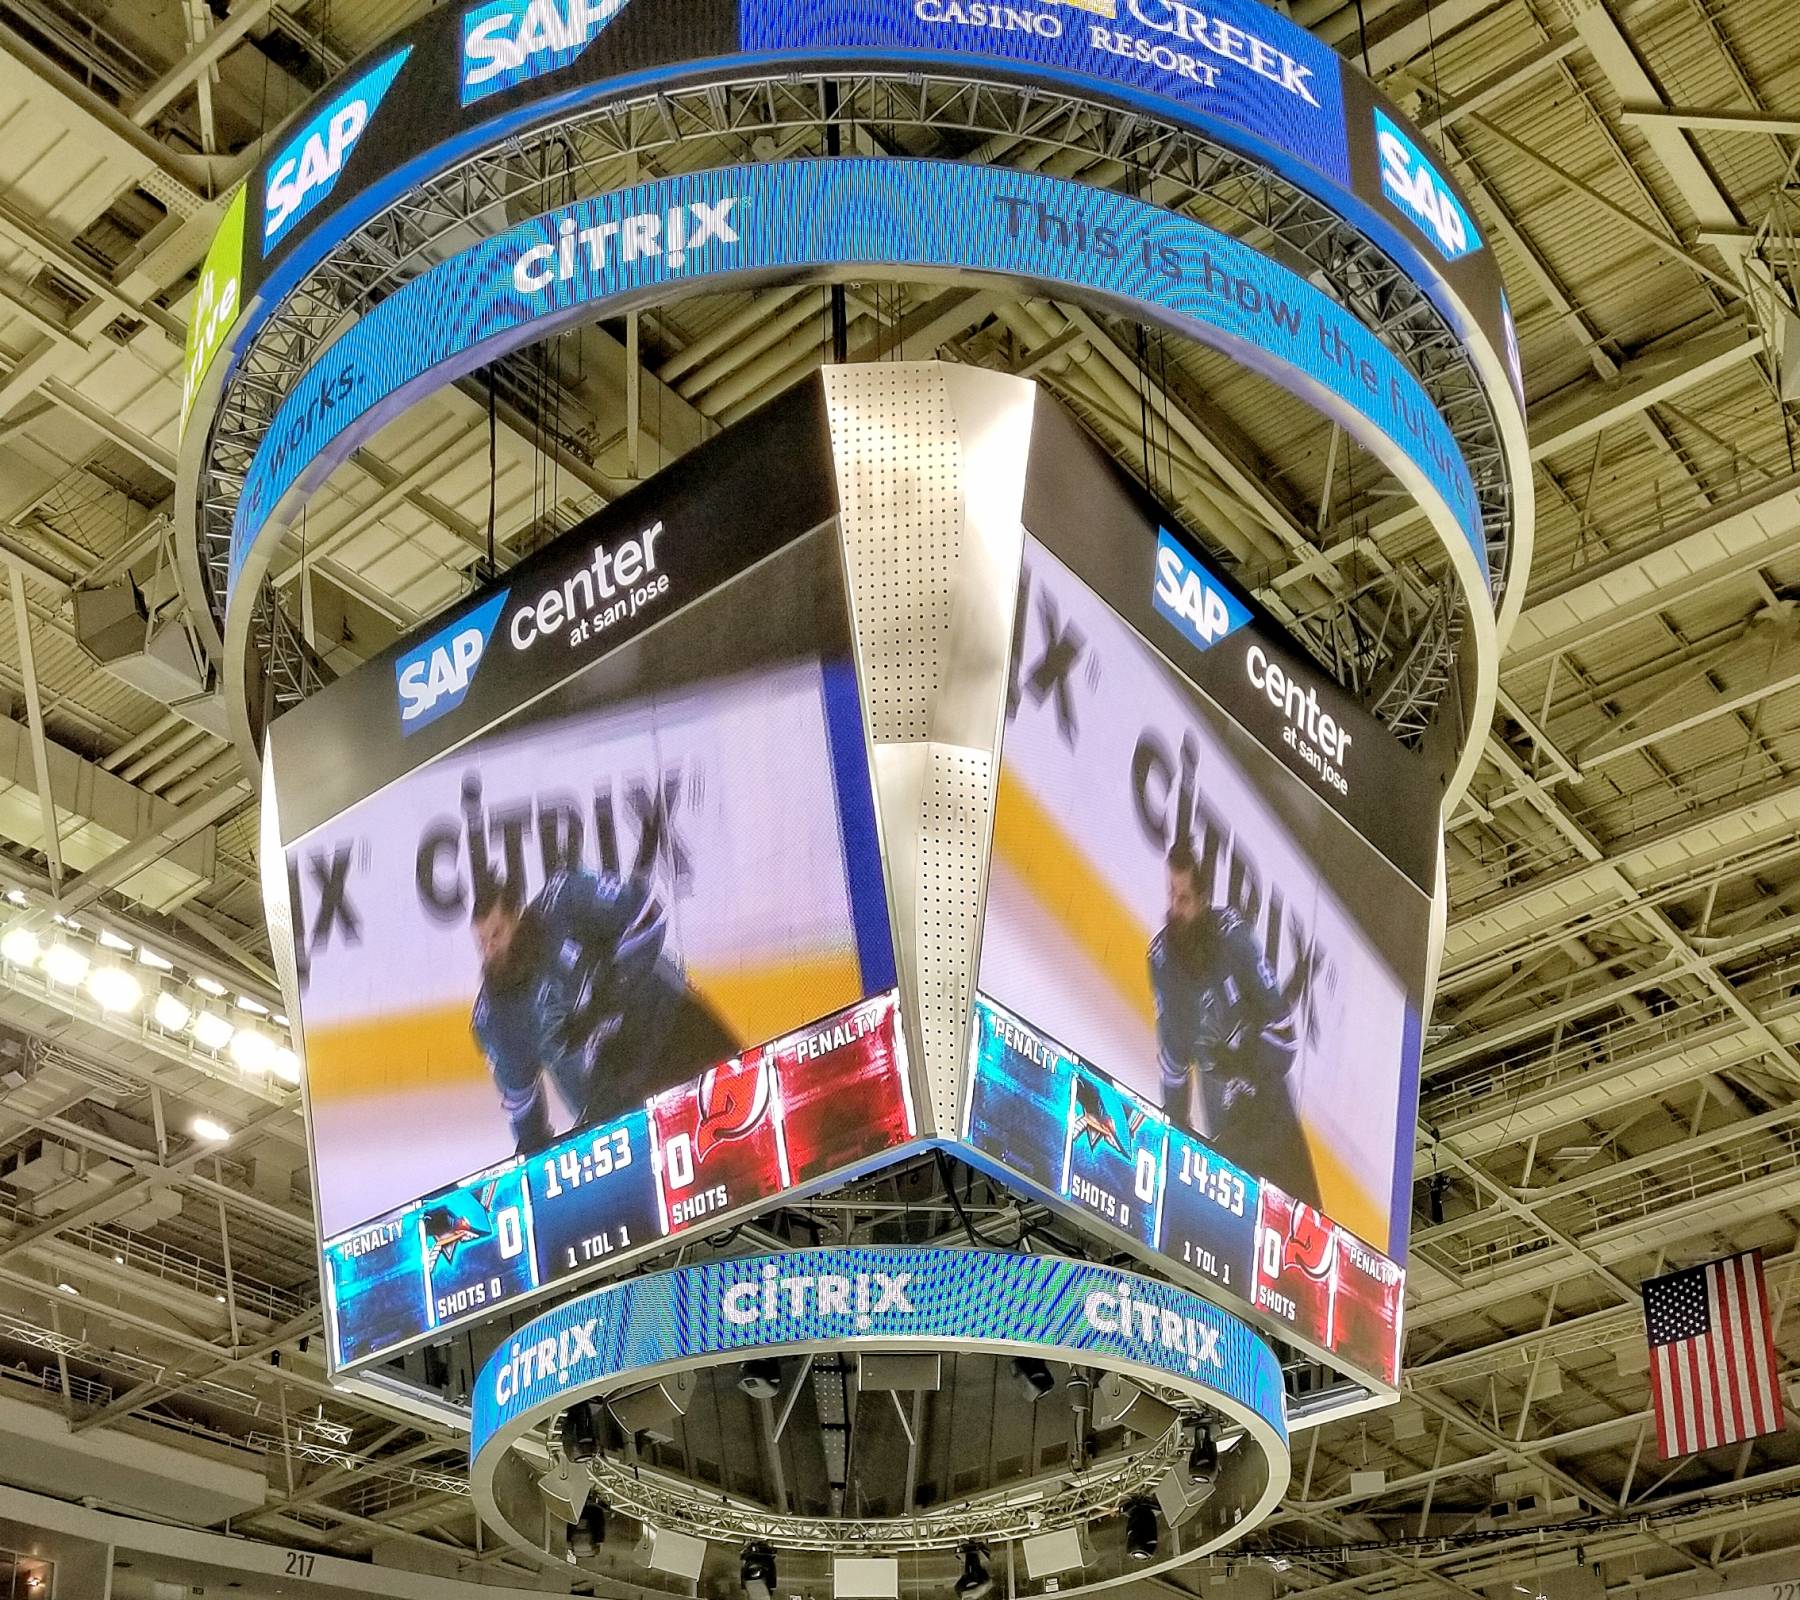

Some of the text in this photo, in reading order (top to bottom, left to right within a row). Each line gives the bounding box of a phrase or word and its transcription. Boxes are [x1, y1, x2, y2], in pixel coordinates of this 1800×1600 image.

[915, 0, 1221, 88] CASINO RESORT
[265, 98, 368, 237] SAP
[1379, 131, 1466, 254] SAP
[993, 194, 1118, 260] This
[1143, 233, 1183, 280] is
[1204, 254, 1301, 339] how
[1317, 313, 1379, 395] the
[399, 520, 665, 721] SAP center
[569, 572, 671, 648] at san jose
[1156, 545, 1353, 768] SAP center
[1282, 723, 1349, 797] at san jose
[796, 1008, 881, 1065] PENALTY
[993, 1013, 1063, 1076] PENALTY
[544, 1127, 634, 1201] 14:53
[665, 1135, 696, 1190] 0
[1134, 1146, 1155, 1205] 0
[1178, 1144, 1247, 1219] 14:53
[671, 1184, 730, 1226] SHOTS
[1071, 1174, 1131, 1227] SHOTS 0
[342, 1220, 404, 1261] PENALTY
[498, 1208, 523, 1261] 0
[567, 1224, 632, 1269] 1 TOL 1
[1183, 1240, 1191, 1262] 1
[1222, 1263, 1231, 1285] 1
[1262, 1226, 1282, 1281] 0
[437, 1276, 502, 1320] SHOTS 0
[1259, 1285, 1297, 1322] SHOTS
[286, 1551, 316, 1578] 217
